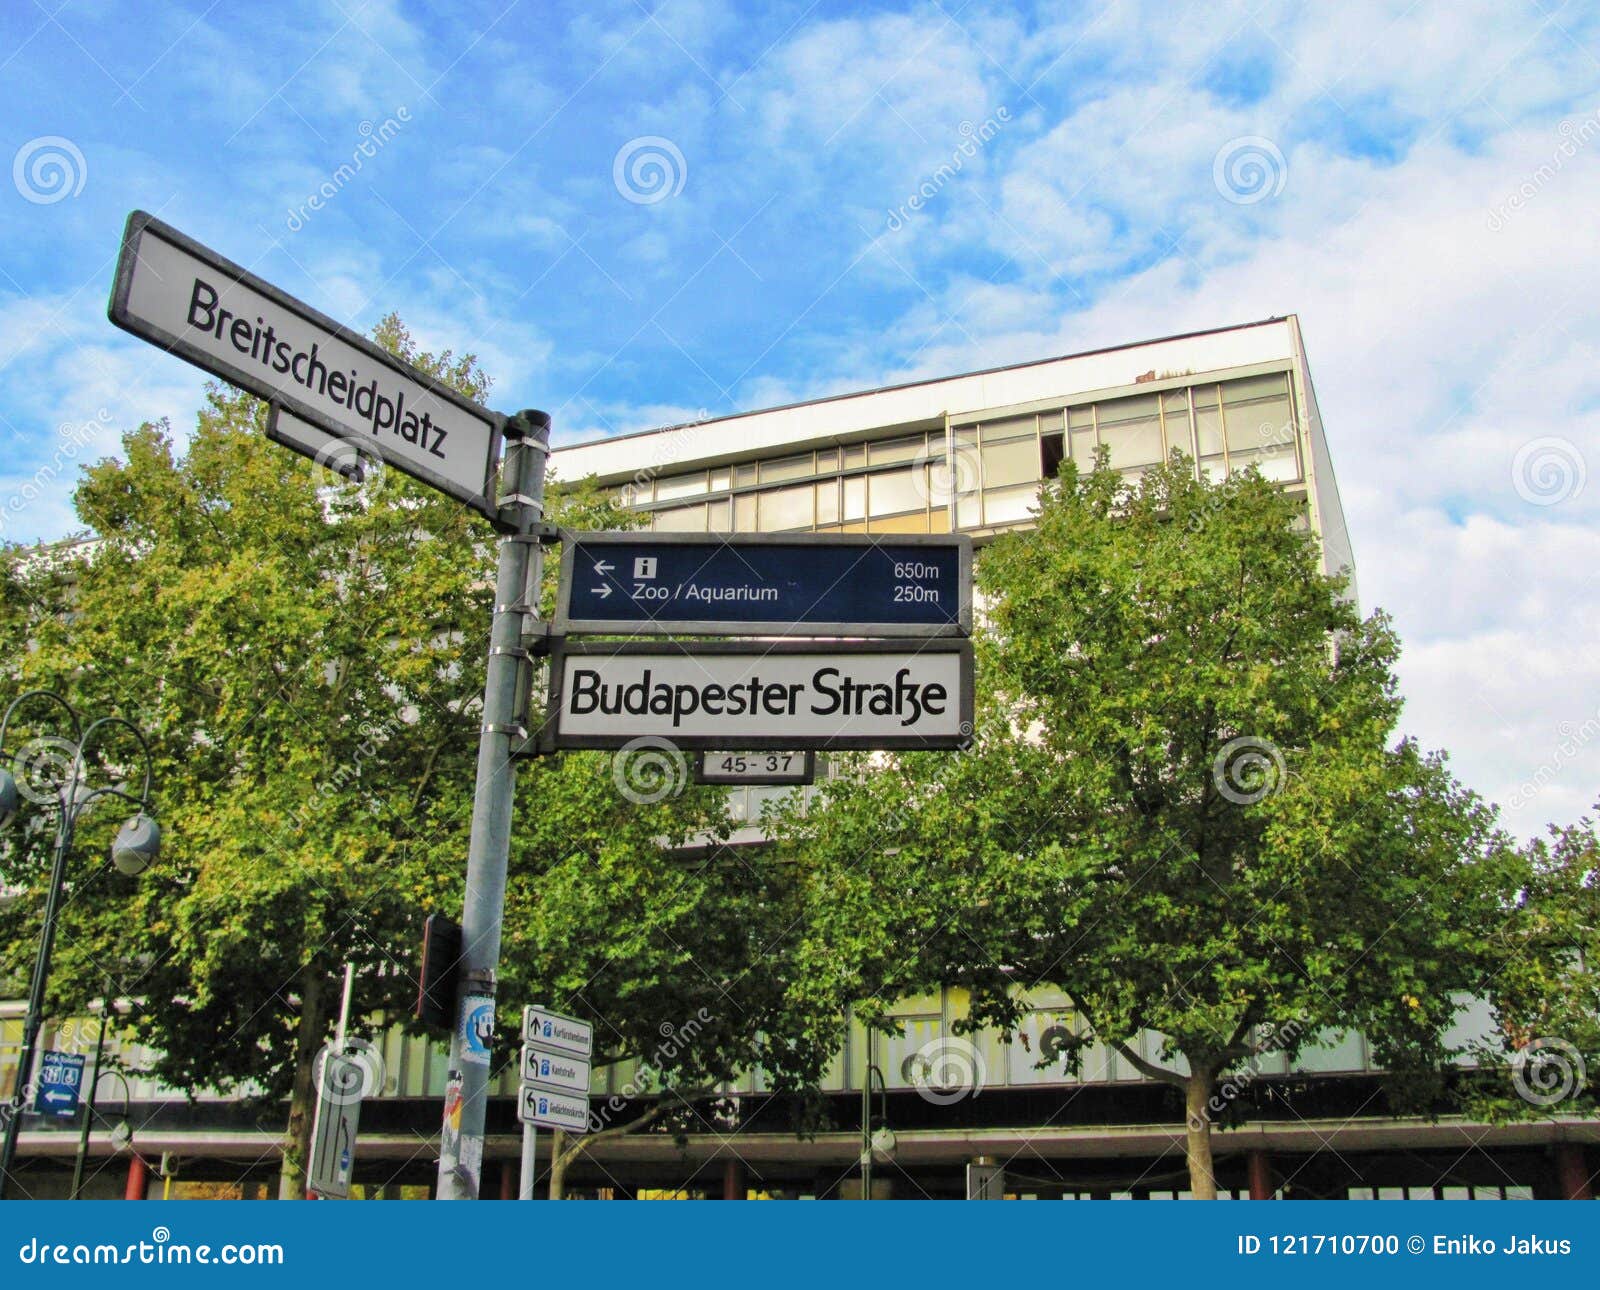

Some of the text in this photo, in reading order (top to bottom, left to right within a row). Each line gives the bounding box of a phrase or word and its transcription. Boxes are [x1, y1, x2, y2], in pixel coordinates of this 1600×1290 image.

[187, 278, 448, 459] Breitscheidplatz
[894, 562, 939, 578] 650m
[632, 583, 669, 600] Zoo
[686, 583, 778, 603] Aquarium
[894, 585, 939, 602] 250m
[570, 667, 948, 727] Budapester Straße
[765, 756, 793, 773] 37
